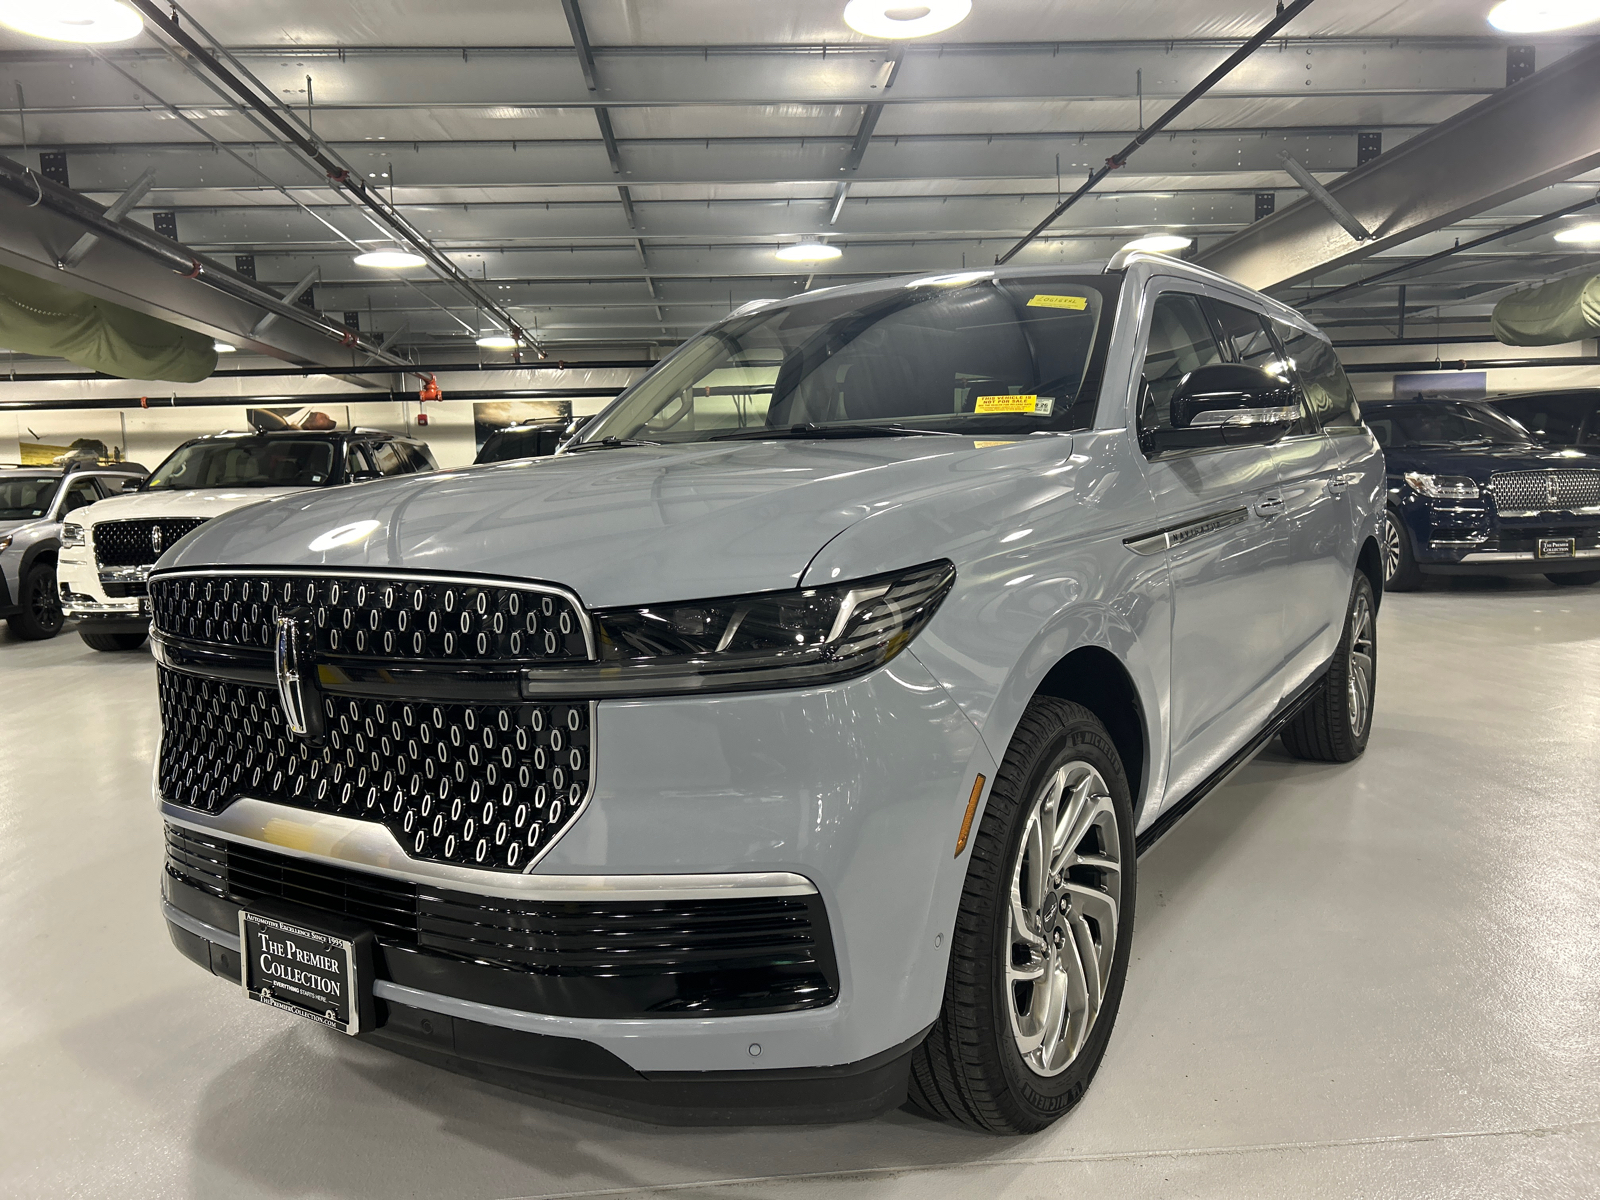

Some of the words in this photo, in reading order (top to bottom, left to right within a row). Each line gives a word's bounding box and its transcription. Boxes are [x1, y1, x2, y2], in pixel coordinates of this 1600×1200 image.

[1172, 521, 1221, 542] NAVIGATOR
[1084, 731, 1121, 773] MICHELIN
[246, 913, 279, 928] AUTOMOTIVE
[279, 921, 311, 937] EXCELLENCE
[311, 931, 327, 942] SINCE
[328, 937, 343, 947] 1995
[257, 932, 285, 957] THE
[285, 940, 340, 974] PREMIER
[260, 953, 341, 997] COLLECTION
[273, 980, 300, 993] EVERYTHING
[300, 989, 315, 999] STARTS
[1022, 1084, 1069, 1110] MICHELIN
